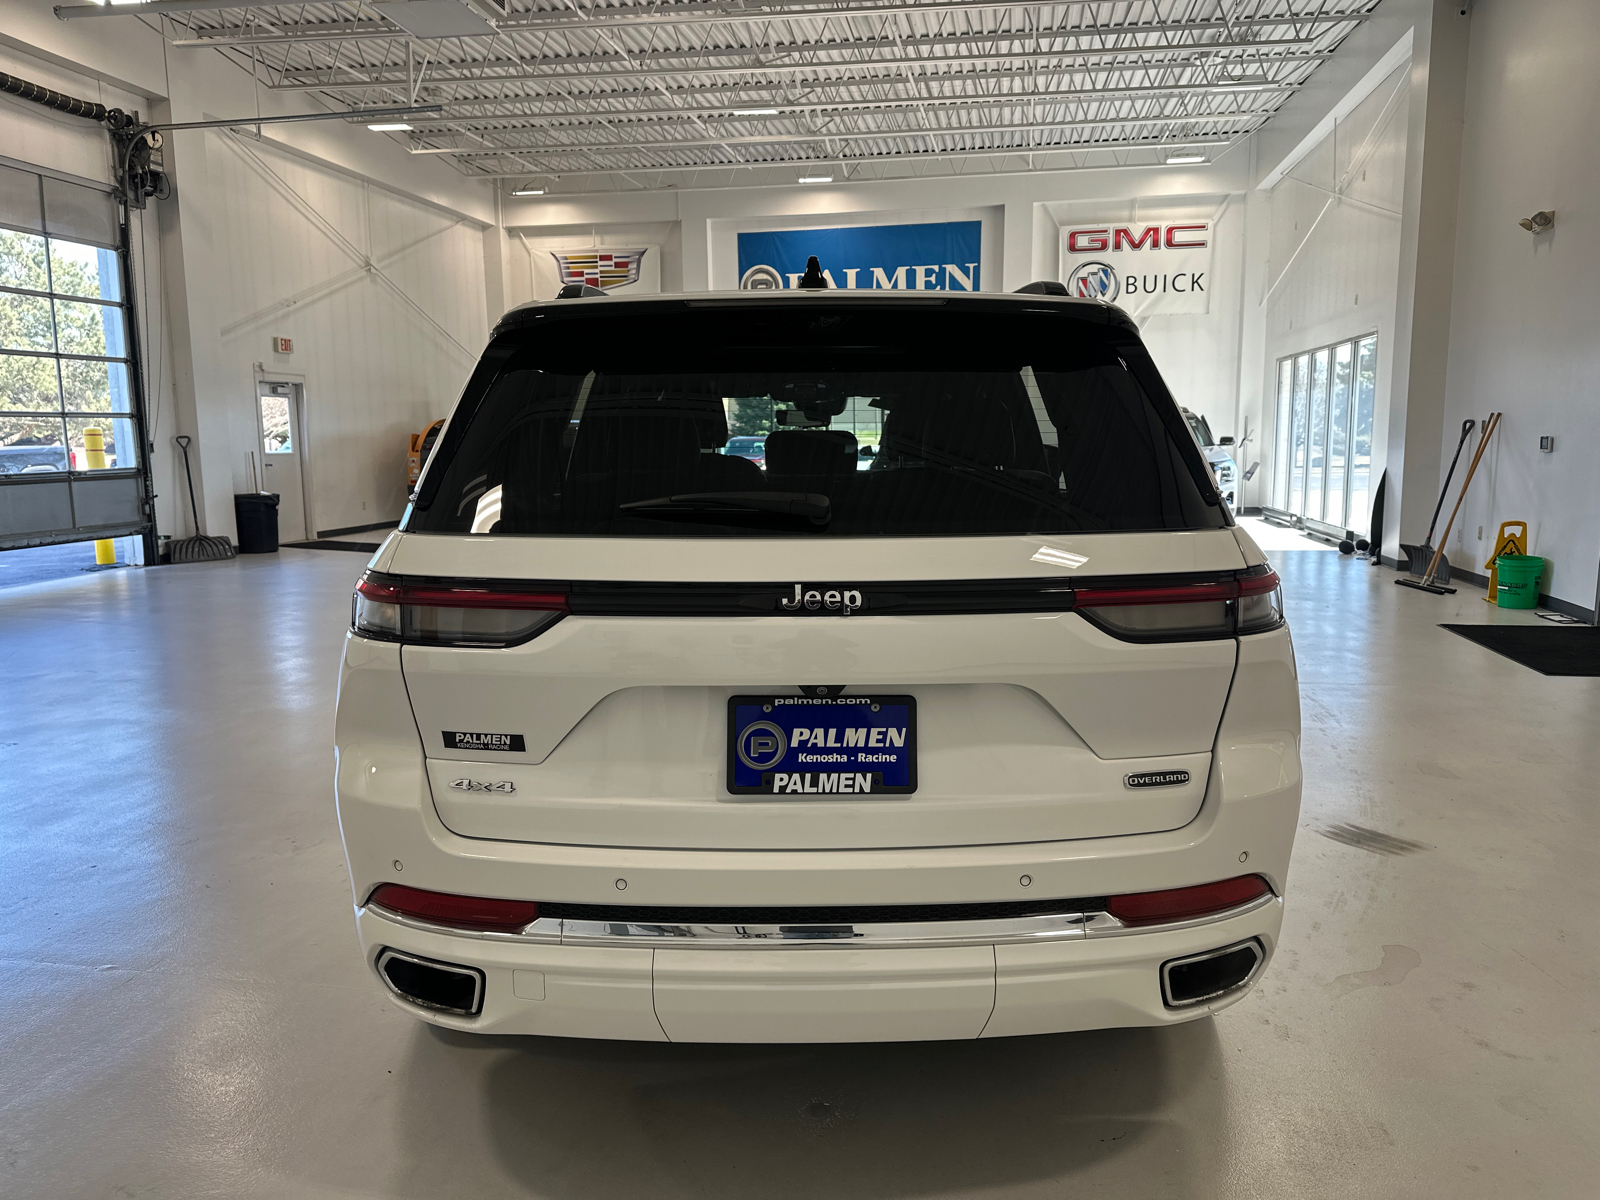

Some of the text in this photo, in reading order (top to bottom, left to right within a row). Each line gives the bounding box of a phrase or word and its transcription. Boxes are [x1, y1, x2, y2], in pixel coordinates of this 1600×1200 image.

[1067, 223, 1208, 254] GMC
[1126, 272, 1205, 295] BUICK
[781, 584, 862, 615] Jeep
[774, 697, 871, 706] palmen.com
[456, 733, 511, 744] PALMEN
[750, 736, 778, 757] P
[790, 727, 907, 748] PALMEN
[797, 752, 848, 763] Kenosha
[857, 752, 898, 763] Racine
[448, 778, 516, 793] 4x4
[772, 772, 872, 794] PALMEN
[1129, 774, 1188, 784] OVERLAND
